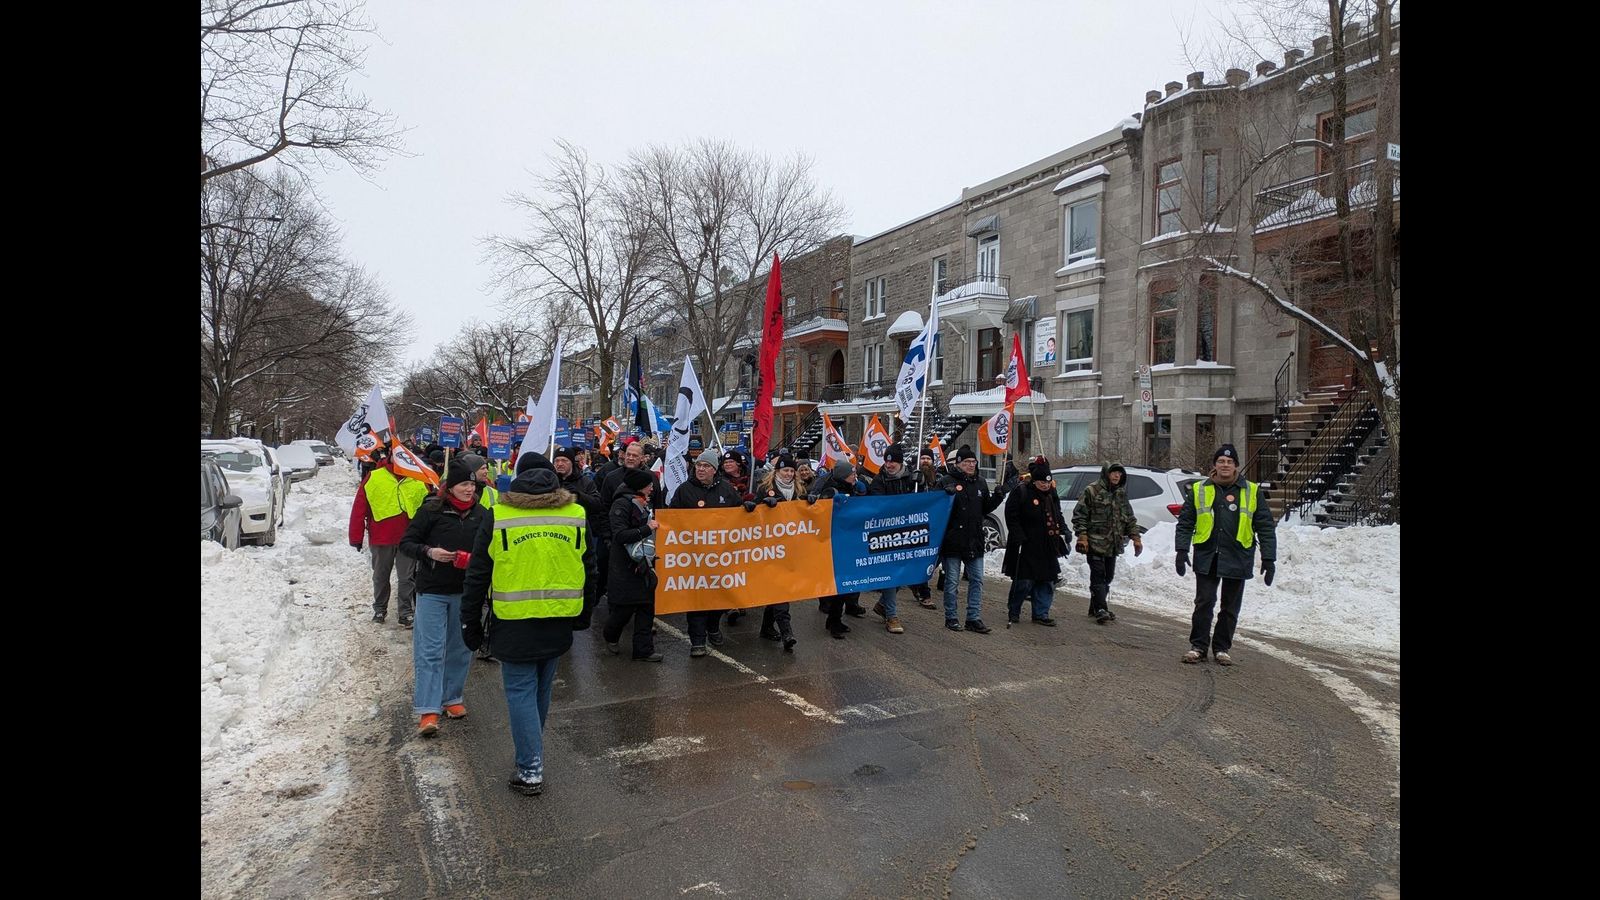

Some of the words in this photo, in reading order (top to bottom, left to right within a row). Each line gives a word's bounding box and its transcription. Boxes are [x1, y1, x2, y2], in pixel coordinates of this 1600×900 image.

[864, 512, 929, 529] DÉLIVRONS-NOUS
[513, 531, 542, 546] SERVICE
[543, 531, 571, 544] D'ORDRE
[664, 527, 762, 546] ACHETONS
[765, 519, 820, 538] LOCAL,
[664, 544, 785, 568] BOYCOTTONS
[855, 558, 868, 567] PAS
[893, 552, 905, 561] PAS
[906, 551, 914, 560] DE
[664, 572, 746, 592] AMAZON
[842, 575, 891, 587] csn.qc.ca/amazon
